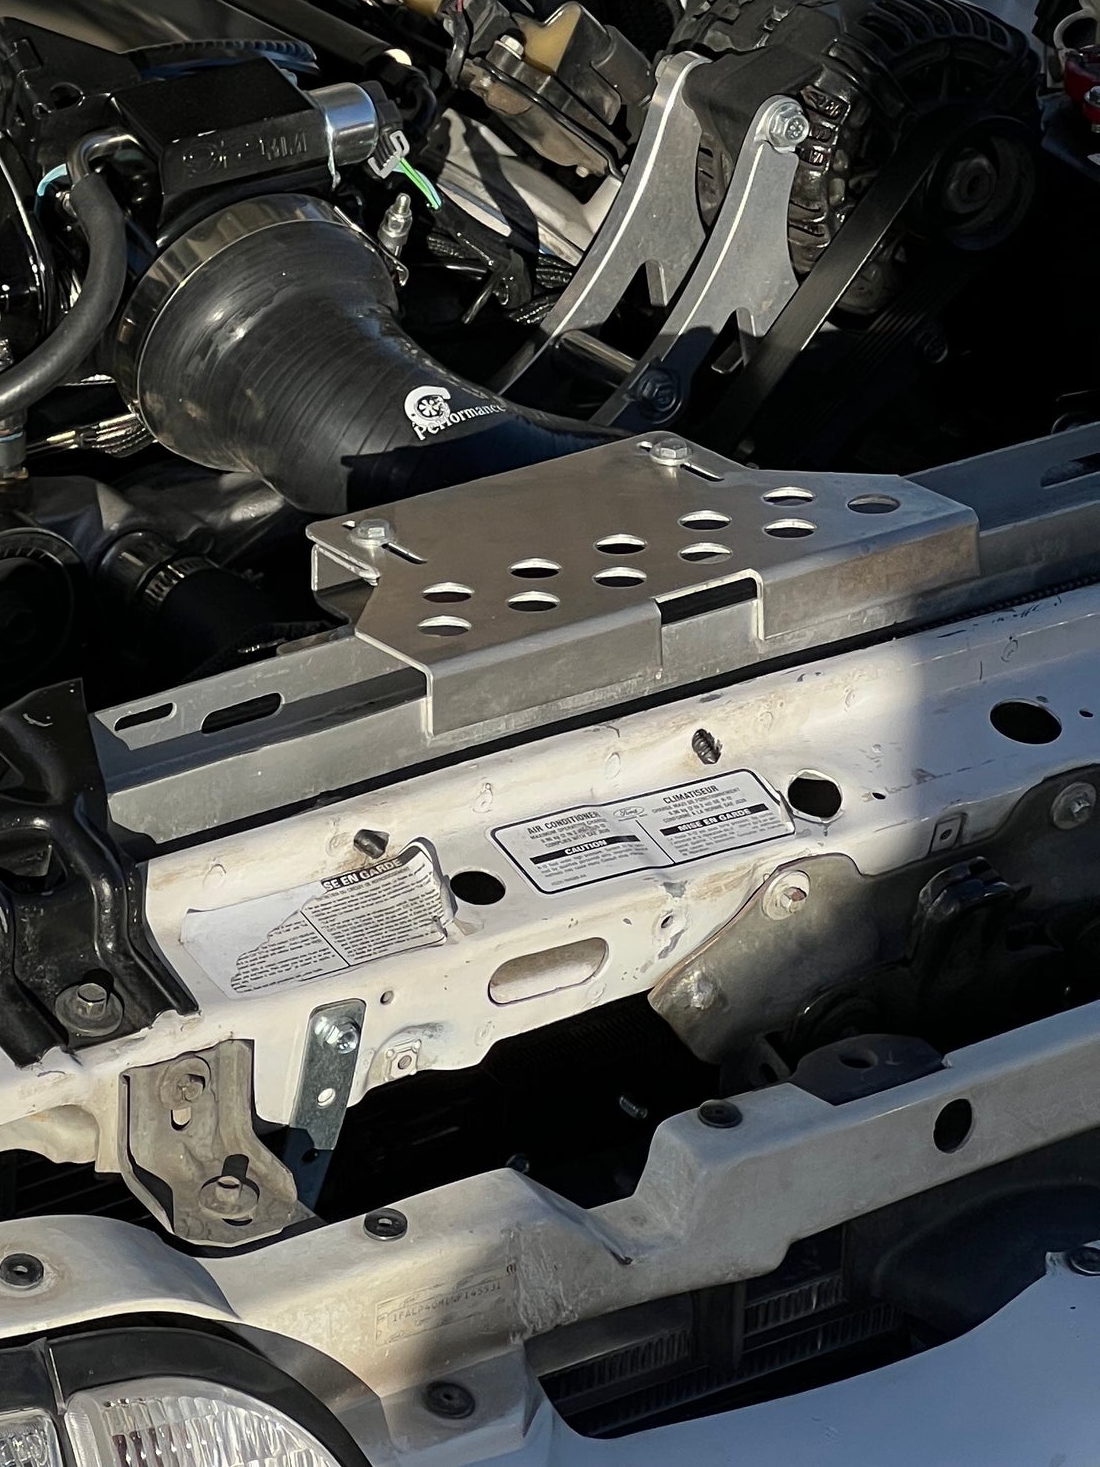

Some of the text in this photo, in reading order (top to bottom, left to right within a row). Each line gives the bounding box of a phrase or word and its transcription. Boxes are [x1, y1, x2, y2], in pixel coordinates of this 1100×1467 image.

[663, 784, 719, 804] CLIMATISEUR
[527, 825, 543, 835] AIR
[544, 810, 601, 830] CONDITIONER
[678, 808, 751, 832] MISE EN GARDE
[564, 839, 607, 856] CAUTION
[323, 859, 403, 891] SE EN GARDE
